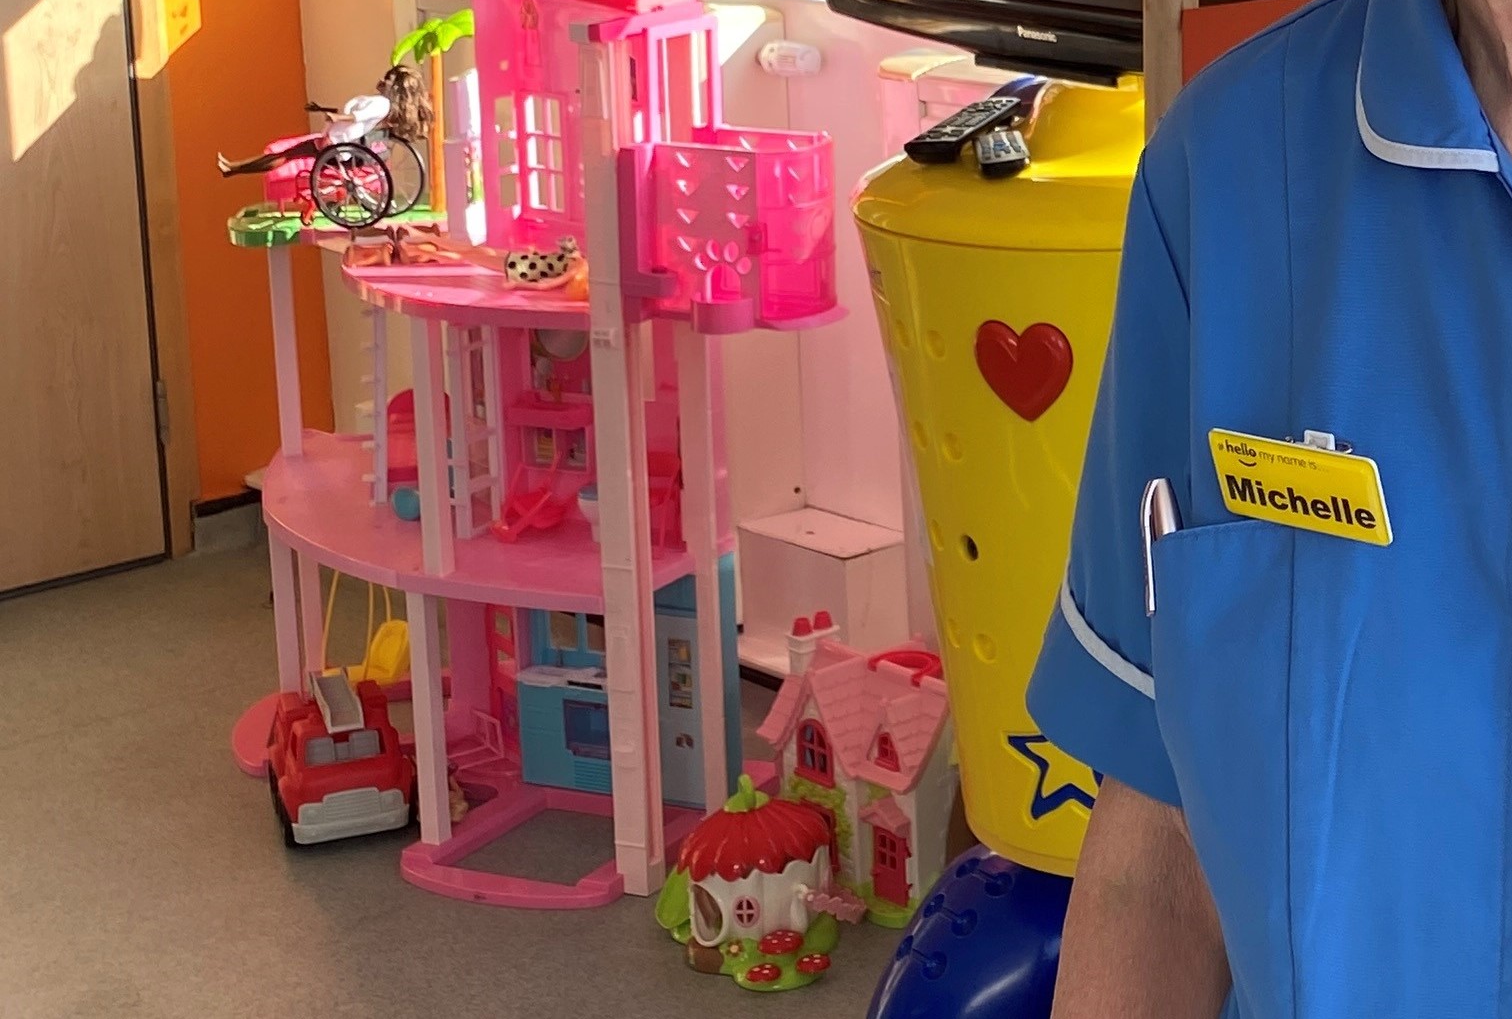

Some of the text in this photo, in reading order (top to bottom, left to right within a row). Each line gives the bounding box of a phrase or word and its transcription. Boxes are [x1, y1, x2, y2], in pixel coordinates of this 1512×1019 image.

[1258, 450, 1275, 464] my
[1278, 455, 1306, 468] name
[1225, 474, 1377, 529] Michelle
